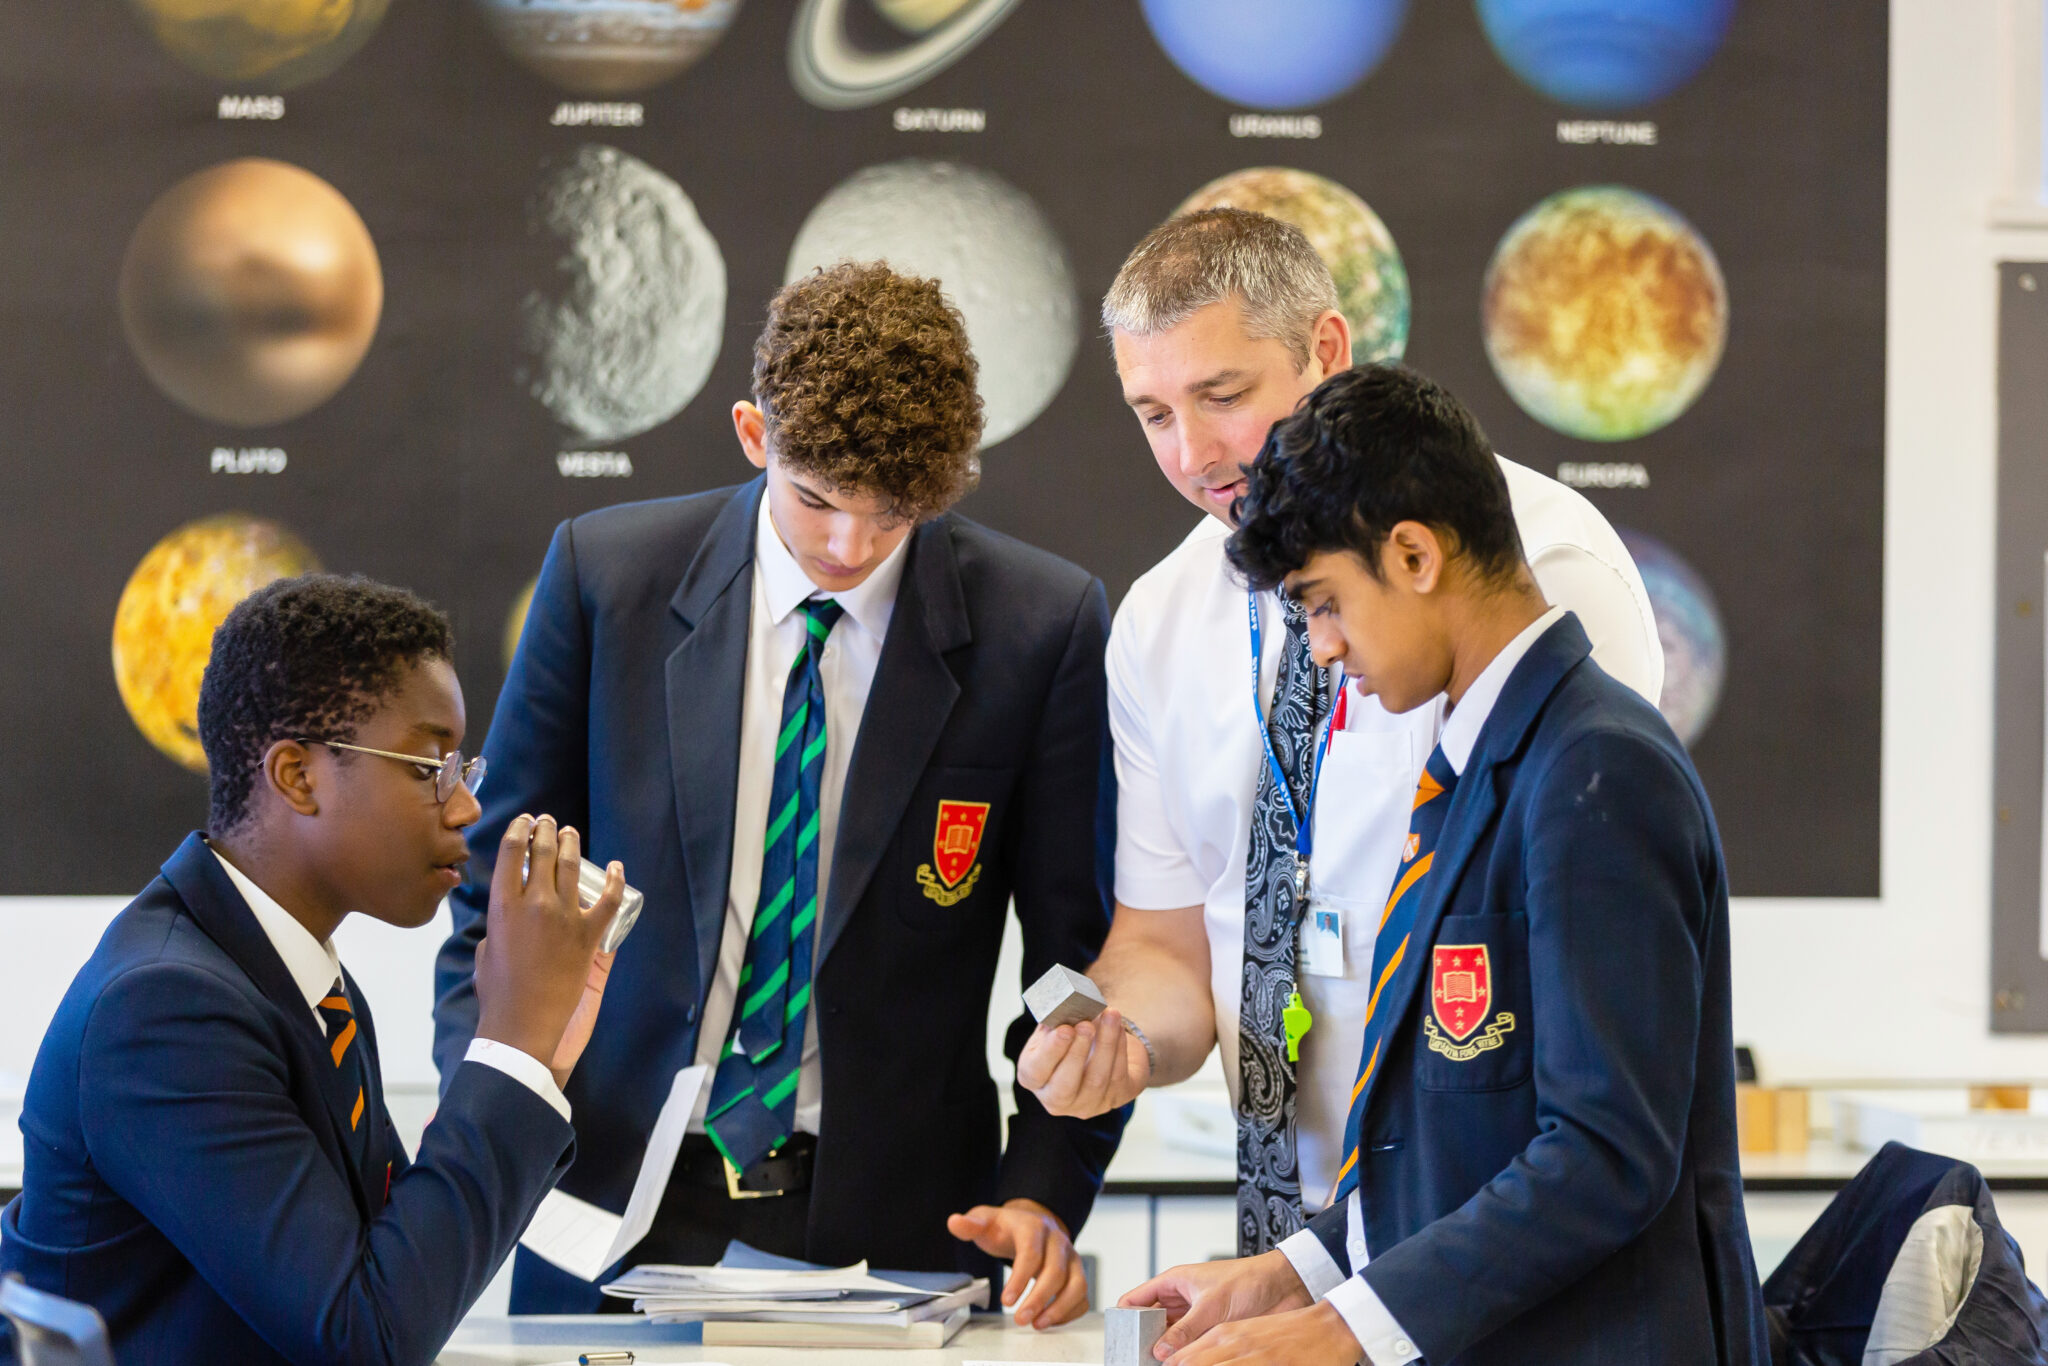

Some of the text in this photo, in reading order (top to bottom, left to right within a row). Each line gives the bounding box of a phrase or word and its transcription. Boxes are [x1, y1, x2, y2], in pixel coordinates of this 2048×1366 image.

[218, 95, 285, 119] MARS
[550, 102, 644, 127] JUPITER
[893, 107, 985, 132] SATURN
[1230, 115, 1322, 138] URANUS
[1556, 121, 1656, 146] NEPTUNE
[211, 447, 287, 474] PLUTO
[556, 451, 633, 477] VESTA
[1557, 462, 1650, 488] EUROPA
